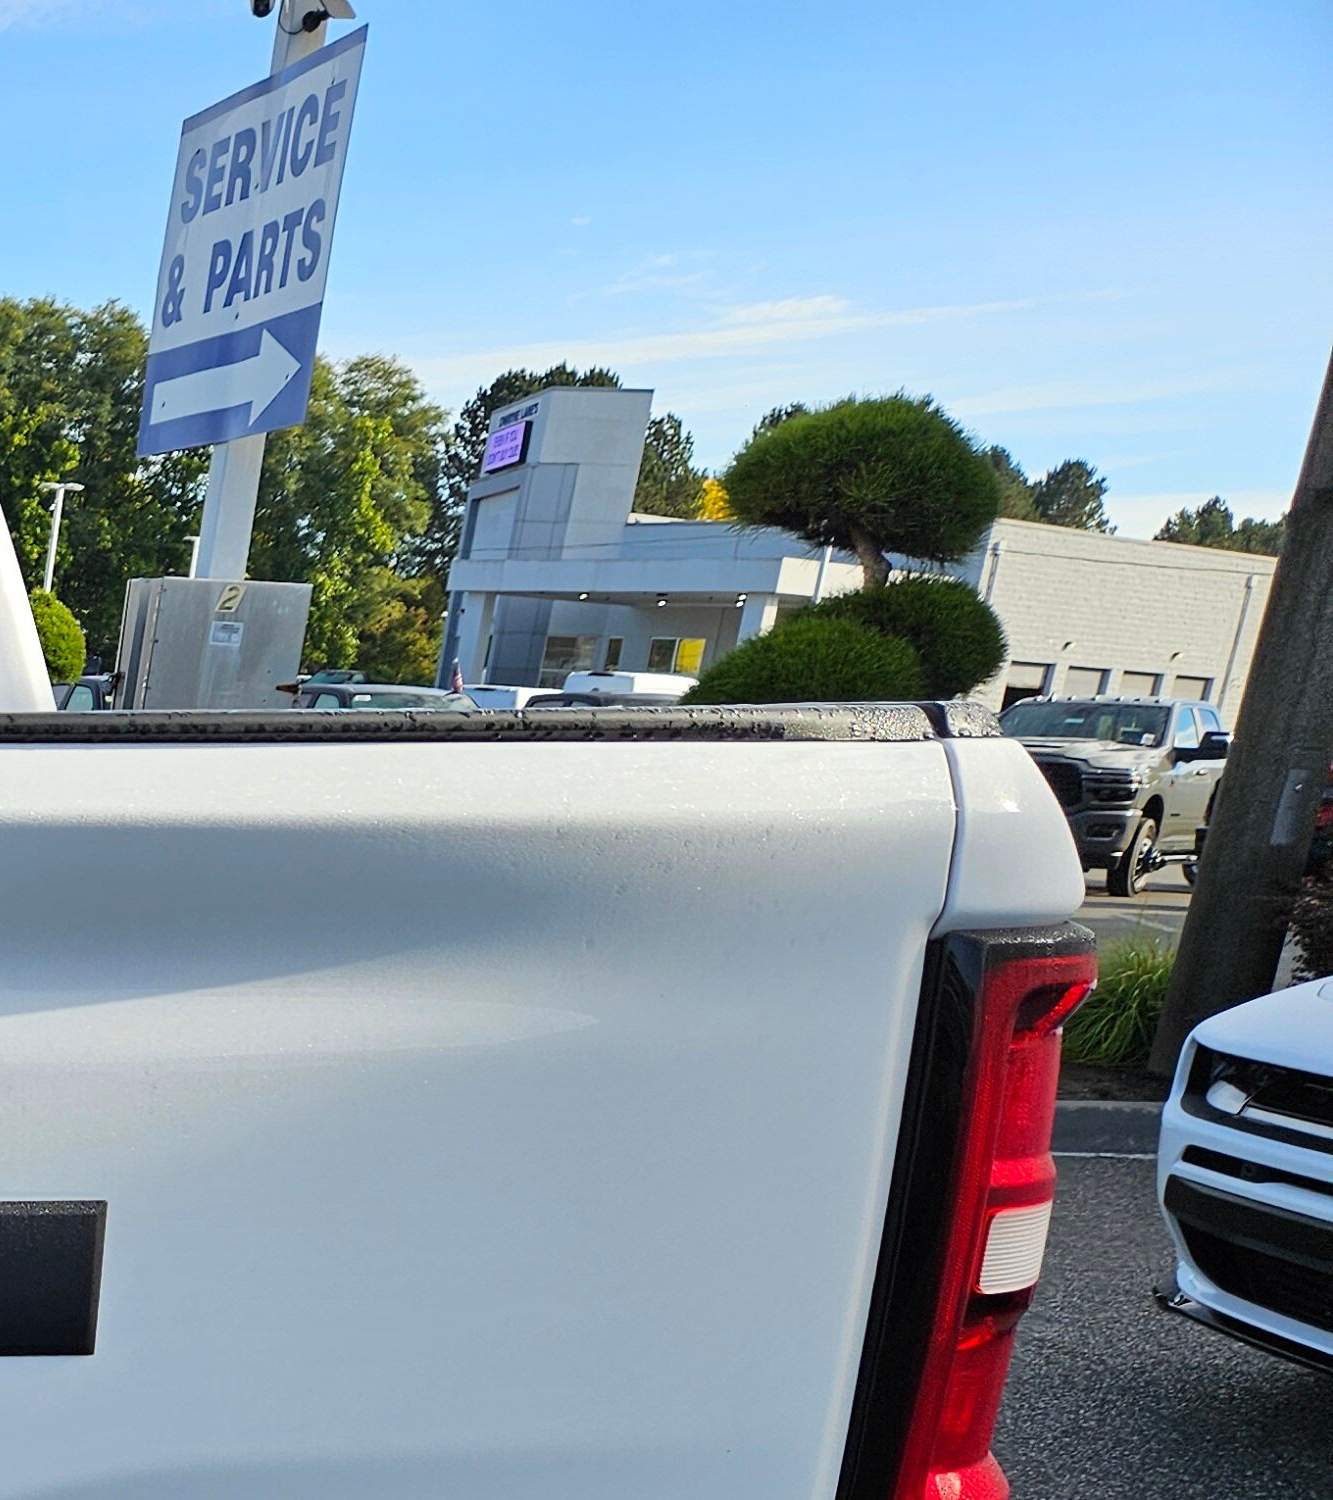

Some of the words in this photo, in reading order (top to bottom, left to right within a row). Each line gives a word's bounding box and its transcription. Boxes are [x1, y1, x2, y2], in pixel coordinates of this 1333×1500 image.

[181, 79, 348, 224] SERVICE
[161, 254, 186, 328] &
[203, 198, 326, 314] PARTS
[218, 586, 240, 610] 2
